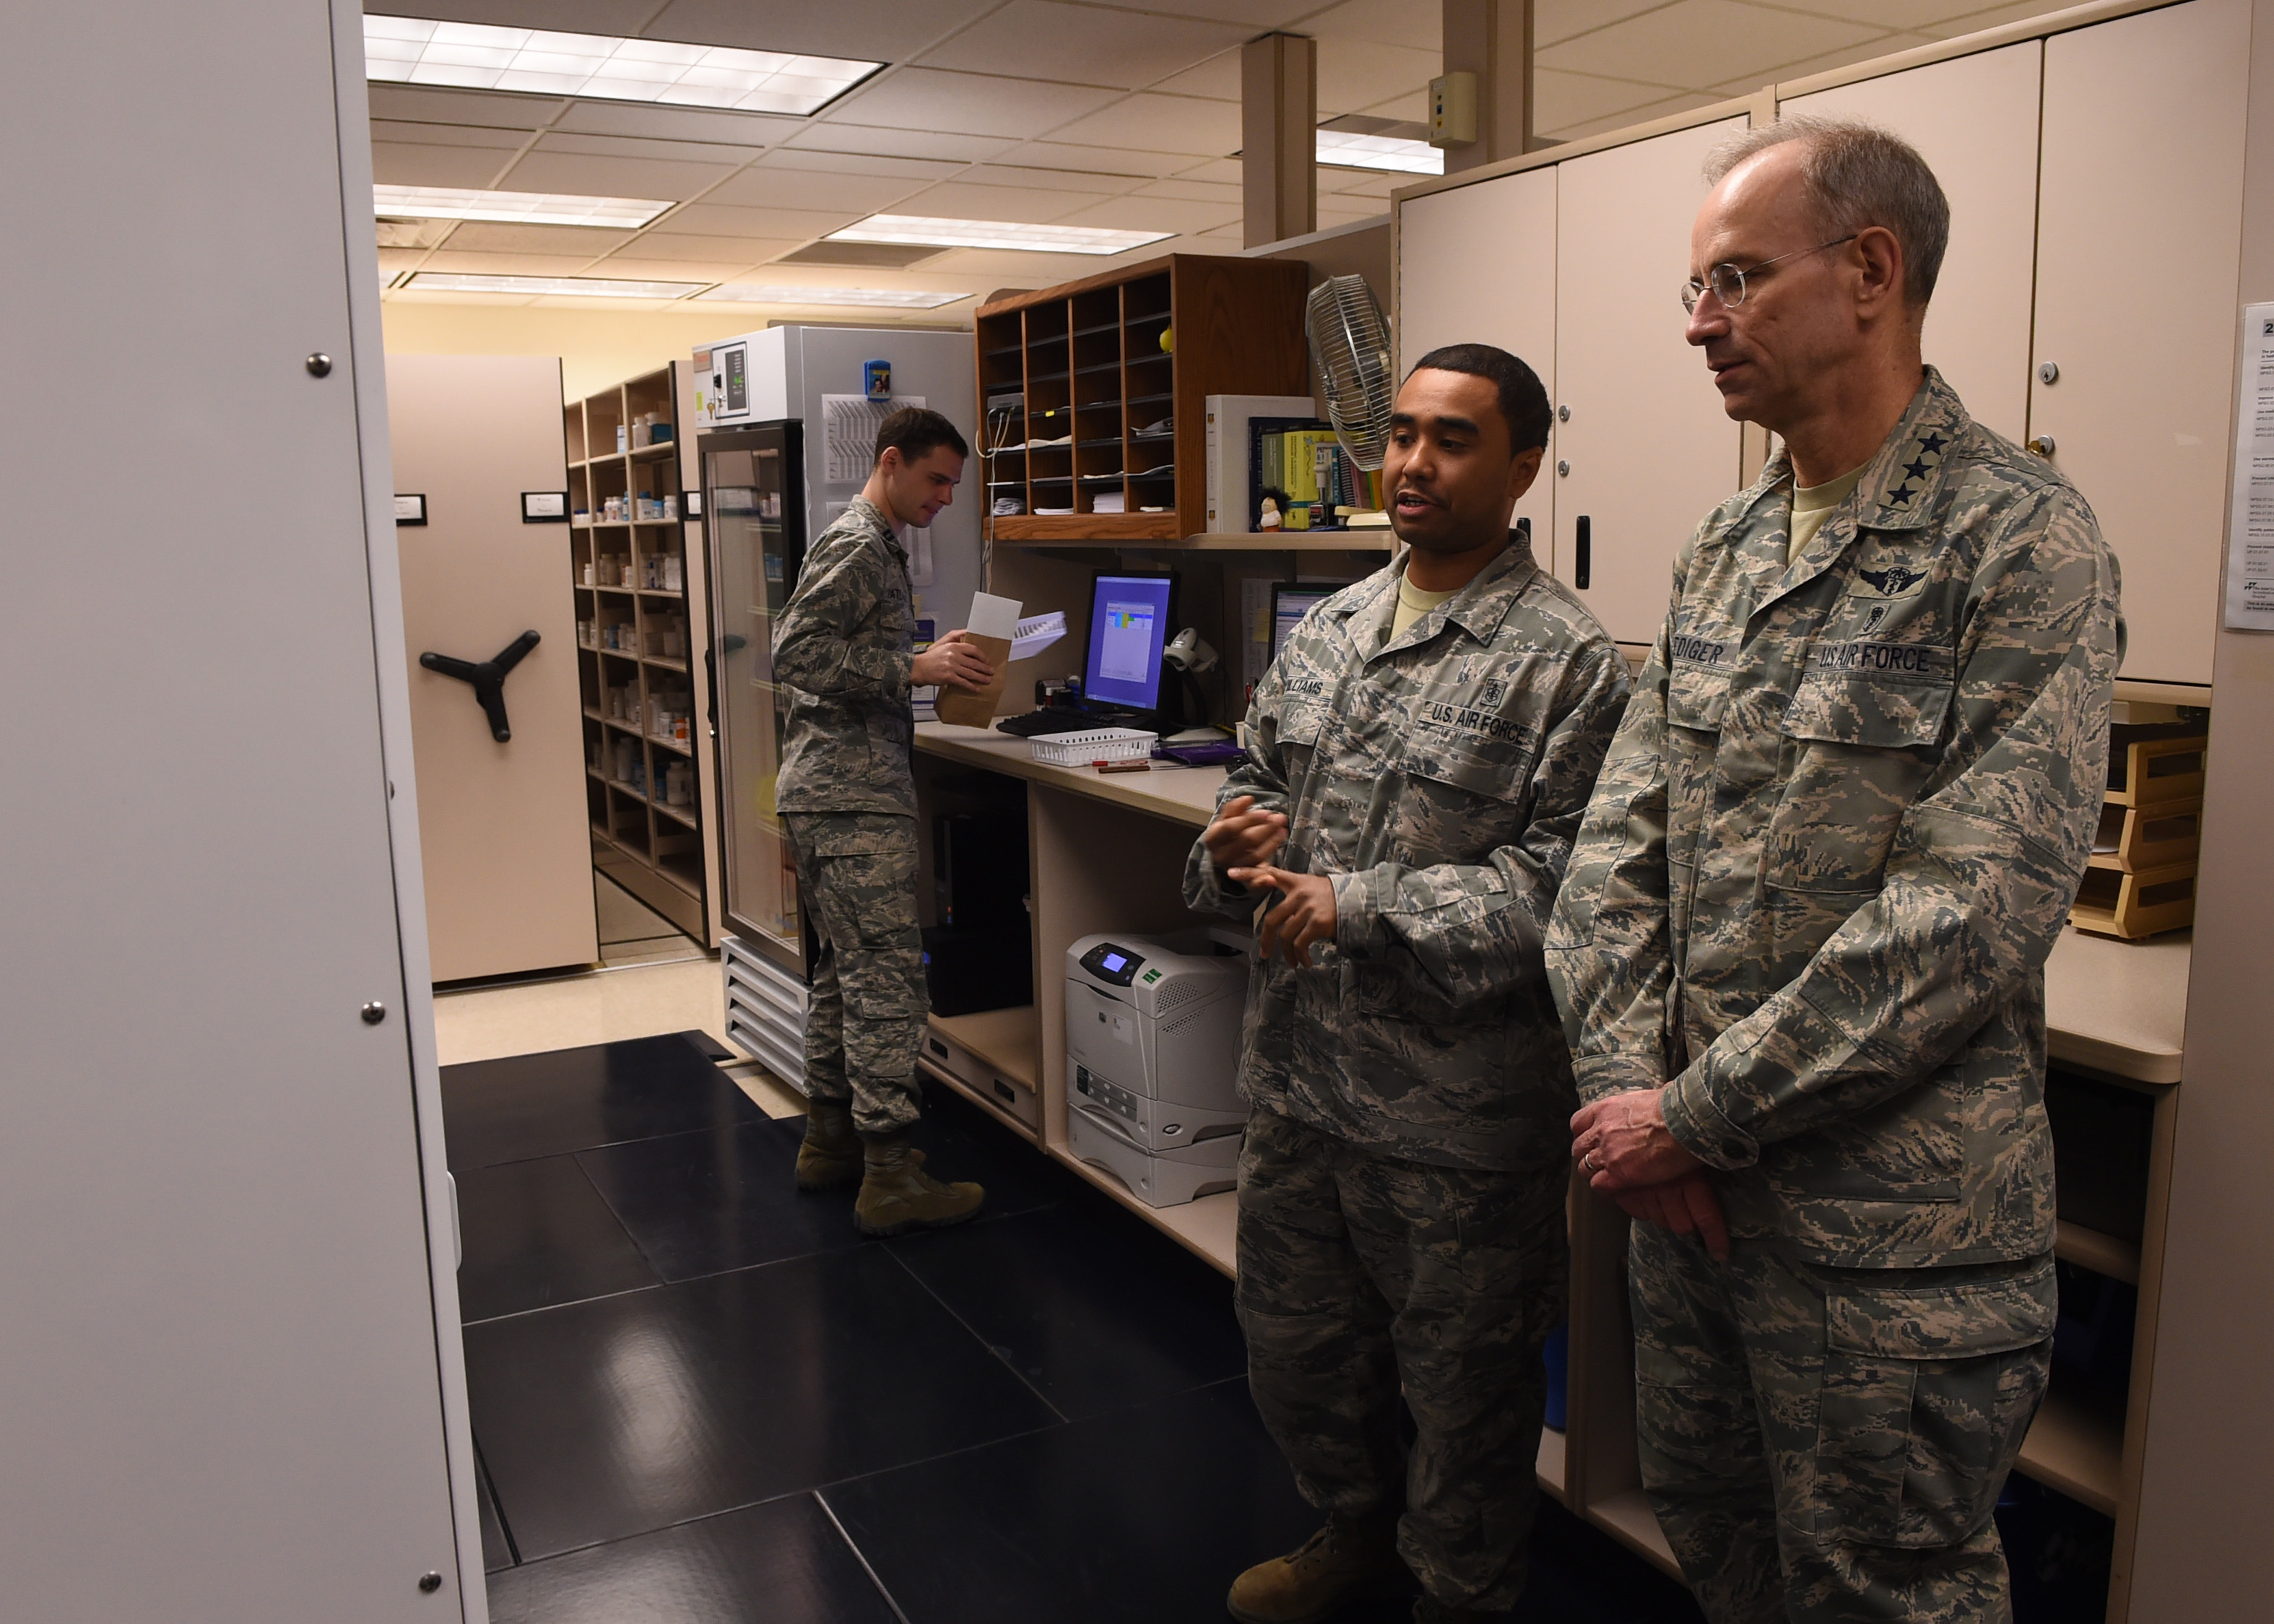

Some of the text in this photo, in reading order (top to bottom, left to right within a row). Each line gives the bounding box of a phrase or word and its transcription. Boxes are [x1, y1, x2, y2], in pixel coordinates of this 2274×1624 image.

[1834, 643, 1859, 666] AIR
[1861, 644, 1930, 672] FORCE
[1285, 678, 1324, 695] ILLIAMS
[1431, 703, 1529, 746] U.S. AIR FORCE
